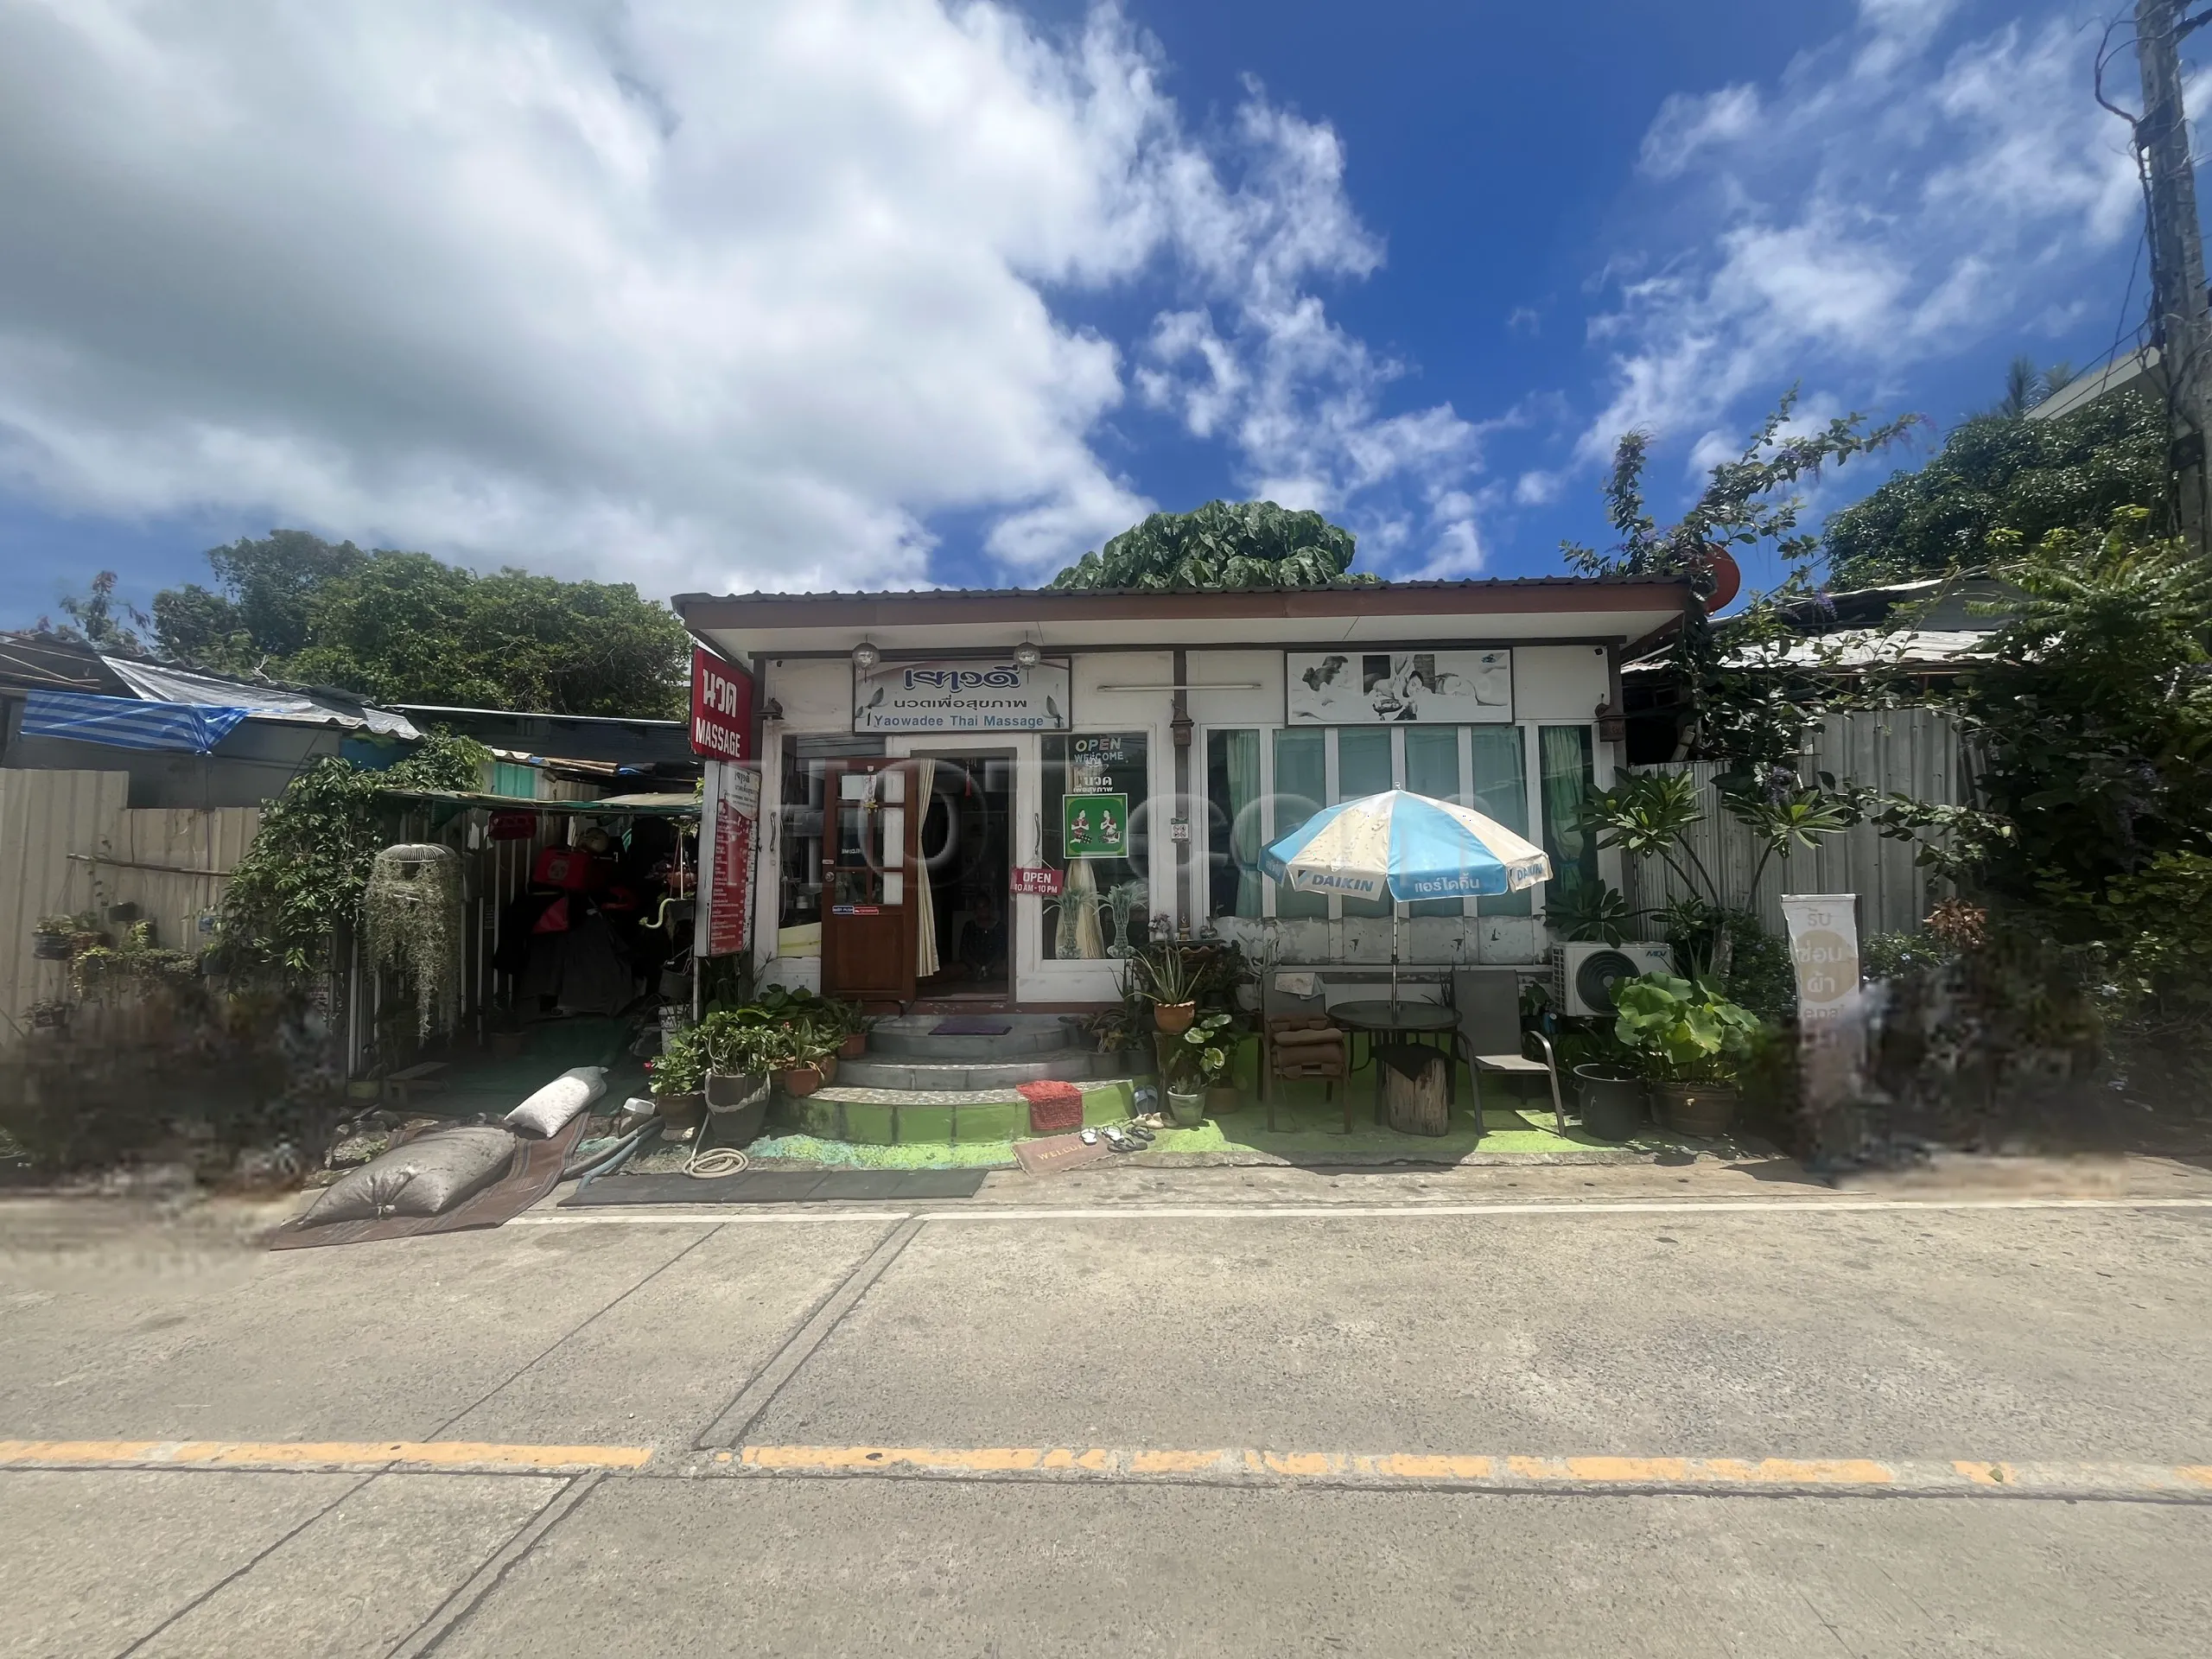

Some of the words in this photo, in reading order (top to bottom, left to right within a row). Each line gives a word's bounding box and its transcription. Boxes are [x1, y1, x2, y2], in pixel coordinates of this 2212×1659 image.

[702, 667, 738, 719] นวด
[893, 694, 1027, 711] นวดเพื่อสุขภาพ
[874, 715, 944, 727] Yaowadee
[950, 715, 978, 727] Thai
[983, 715, 1045, 729] Massage
[695, 715, 741, 759] MASSAGE
[1075, 737, 1122, 753] OPEN
[1084, 776, 1113, 786] นวด
[1022, 871, 1052, 884] OPEN
[1311, 874, 1376, 893] DAIKIN
[1807, 908, 1832, 927] รับ
[1807, 970, 1836, 994] ผ้า
